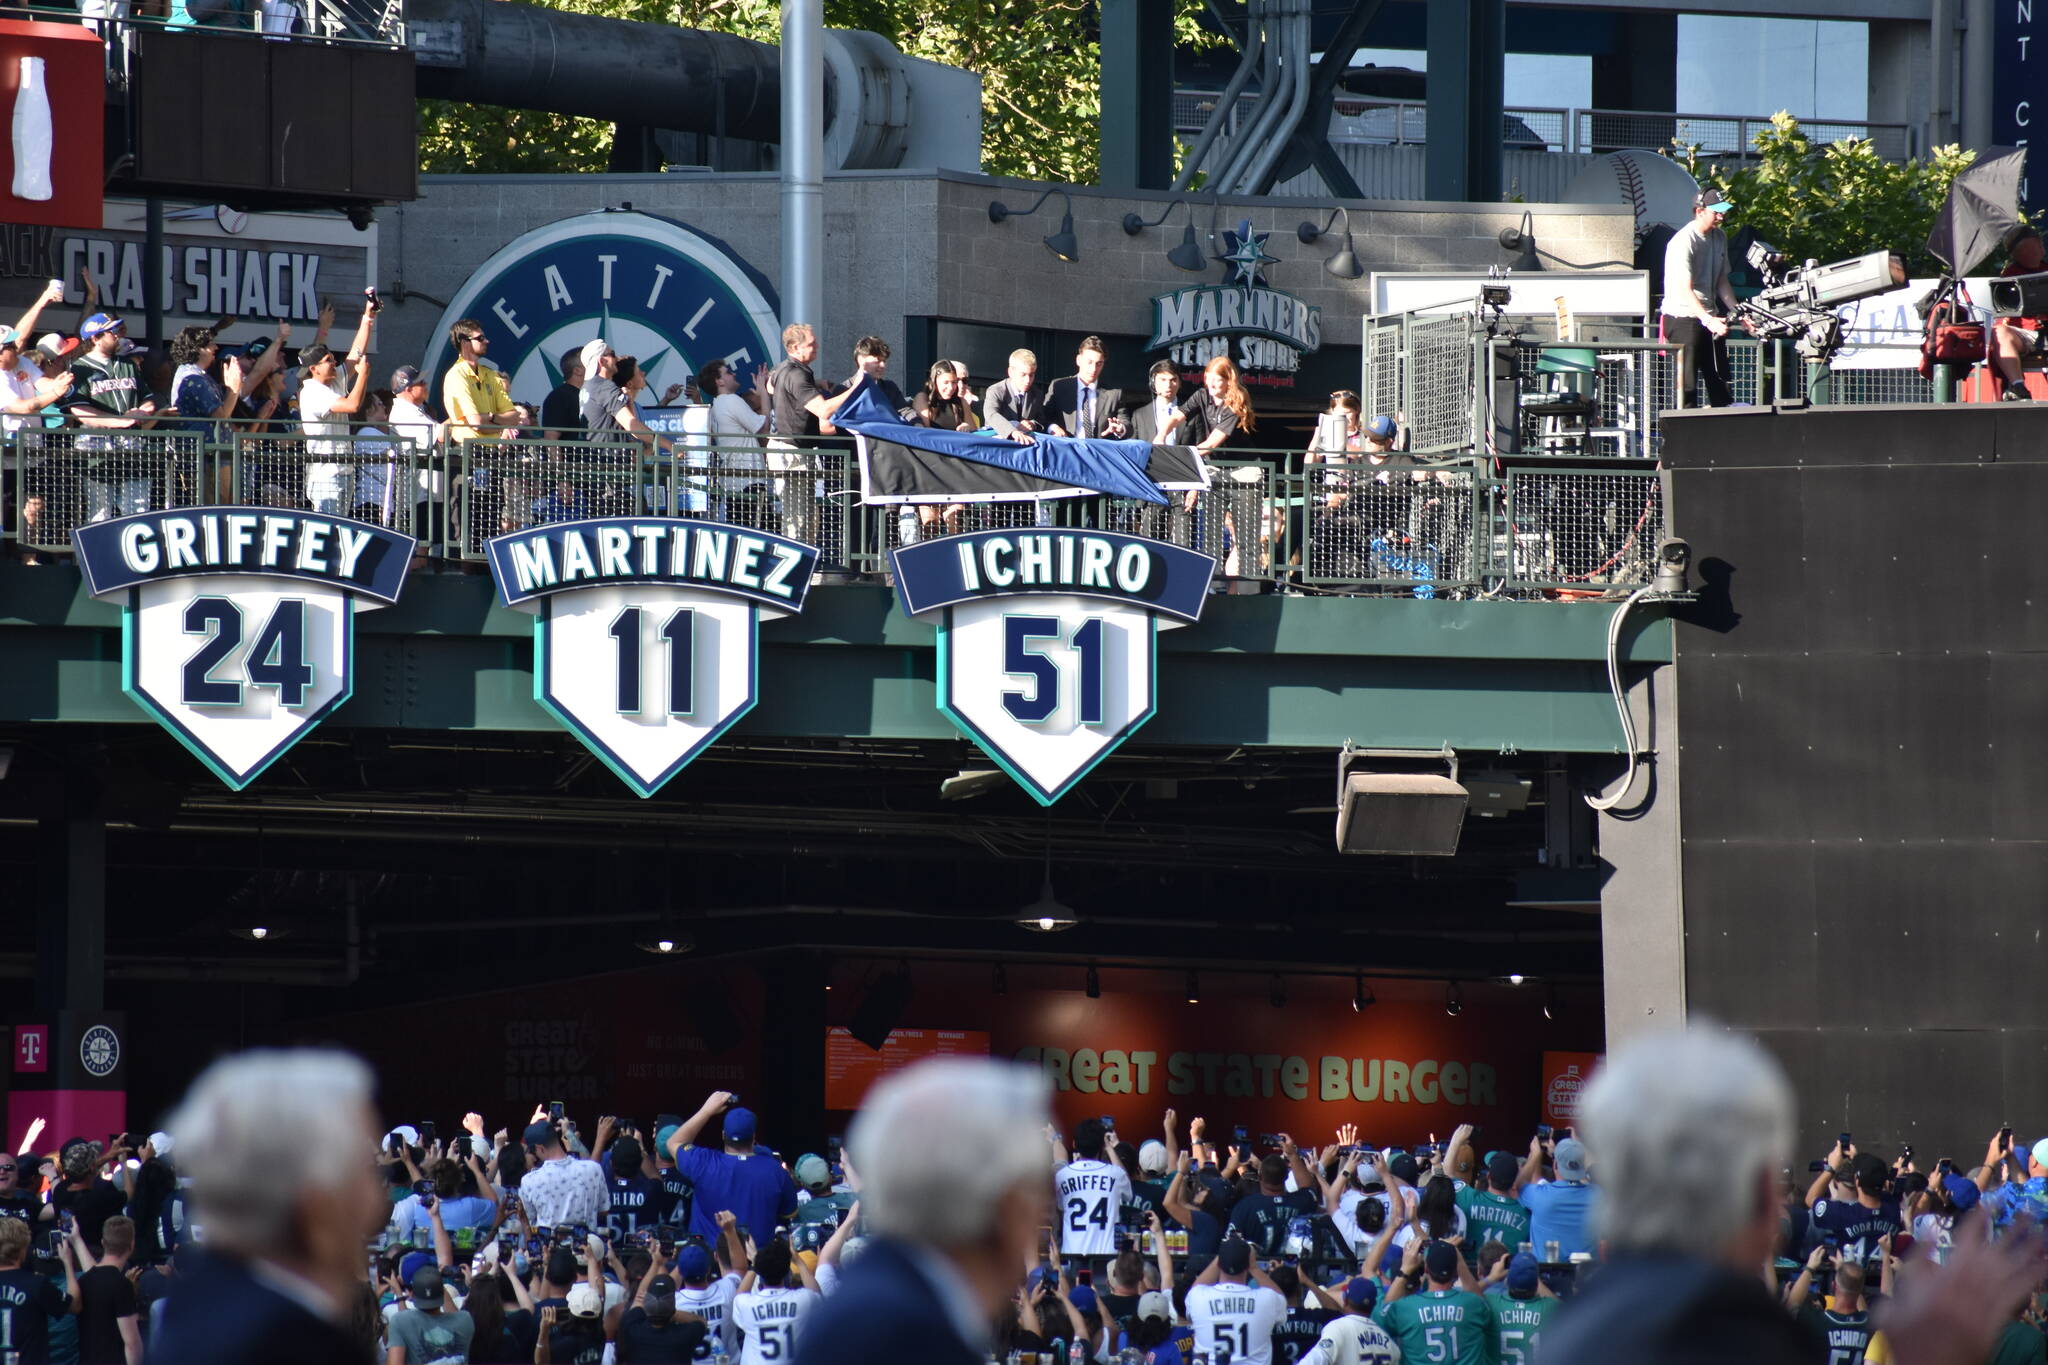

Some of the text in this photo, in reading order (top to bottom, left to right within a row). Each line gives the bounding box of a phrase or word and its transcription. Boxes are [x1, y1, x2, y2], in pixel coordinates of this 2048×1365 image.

[185, 247, 320, 321] SHACK
[480, 254, 752, 375] EATTLE
[1152, 287, 1321, 351] MARINERS
[1834, 302, 1921, 358] SEA
[1169, 335, 1301, 373] TEAM STORE
[120, 514, 374, 579] GRIFFEY
[509, 525, 803, 599] MARTINEZ
[957, 535, 1151, 594] ICHIRO
[181, 594, 315, 708] 24
[608, 605, 695, 716] 11
[1000, 613, 1104, 725] 51
[611, 1191, 645, 1207] HIRO
[1061, 1175, 1116, 1196] GRIFFEY
[1067, 1196, 1109, 1232] 24
[1470, 1204, 1527, 1232] MARTINEZ
[751, 1301, 798, 1321] ICHIRO
[1208, 1298, 1256, 1316] ICHIRO
[1418, 1305, 1464, 1324] ICHIRO
[1500, 1309, 1541, 1327] ICHIRO
[759, 1323, 794, 1360] 51
[1213, 1322, 1249, 1358] 51
[1425, 1326, 1459, 1362] 51
[1828, 1330, 1868, 1348] ICHIRO
